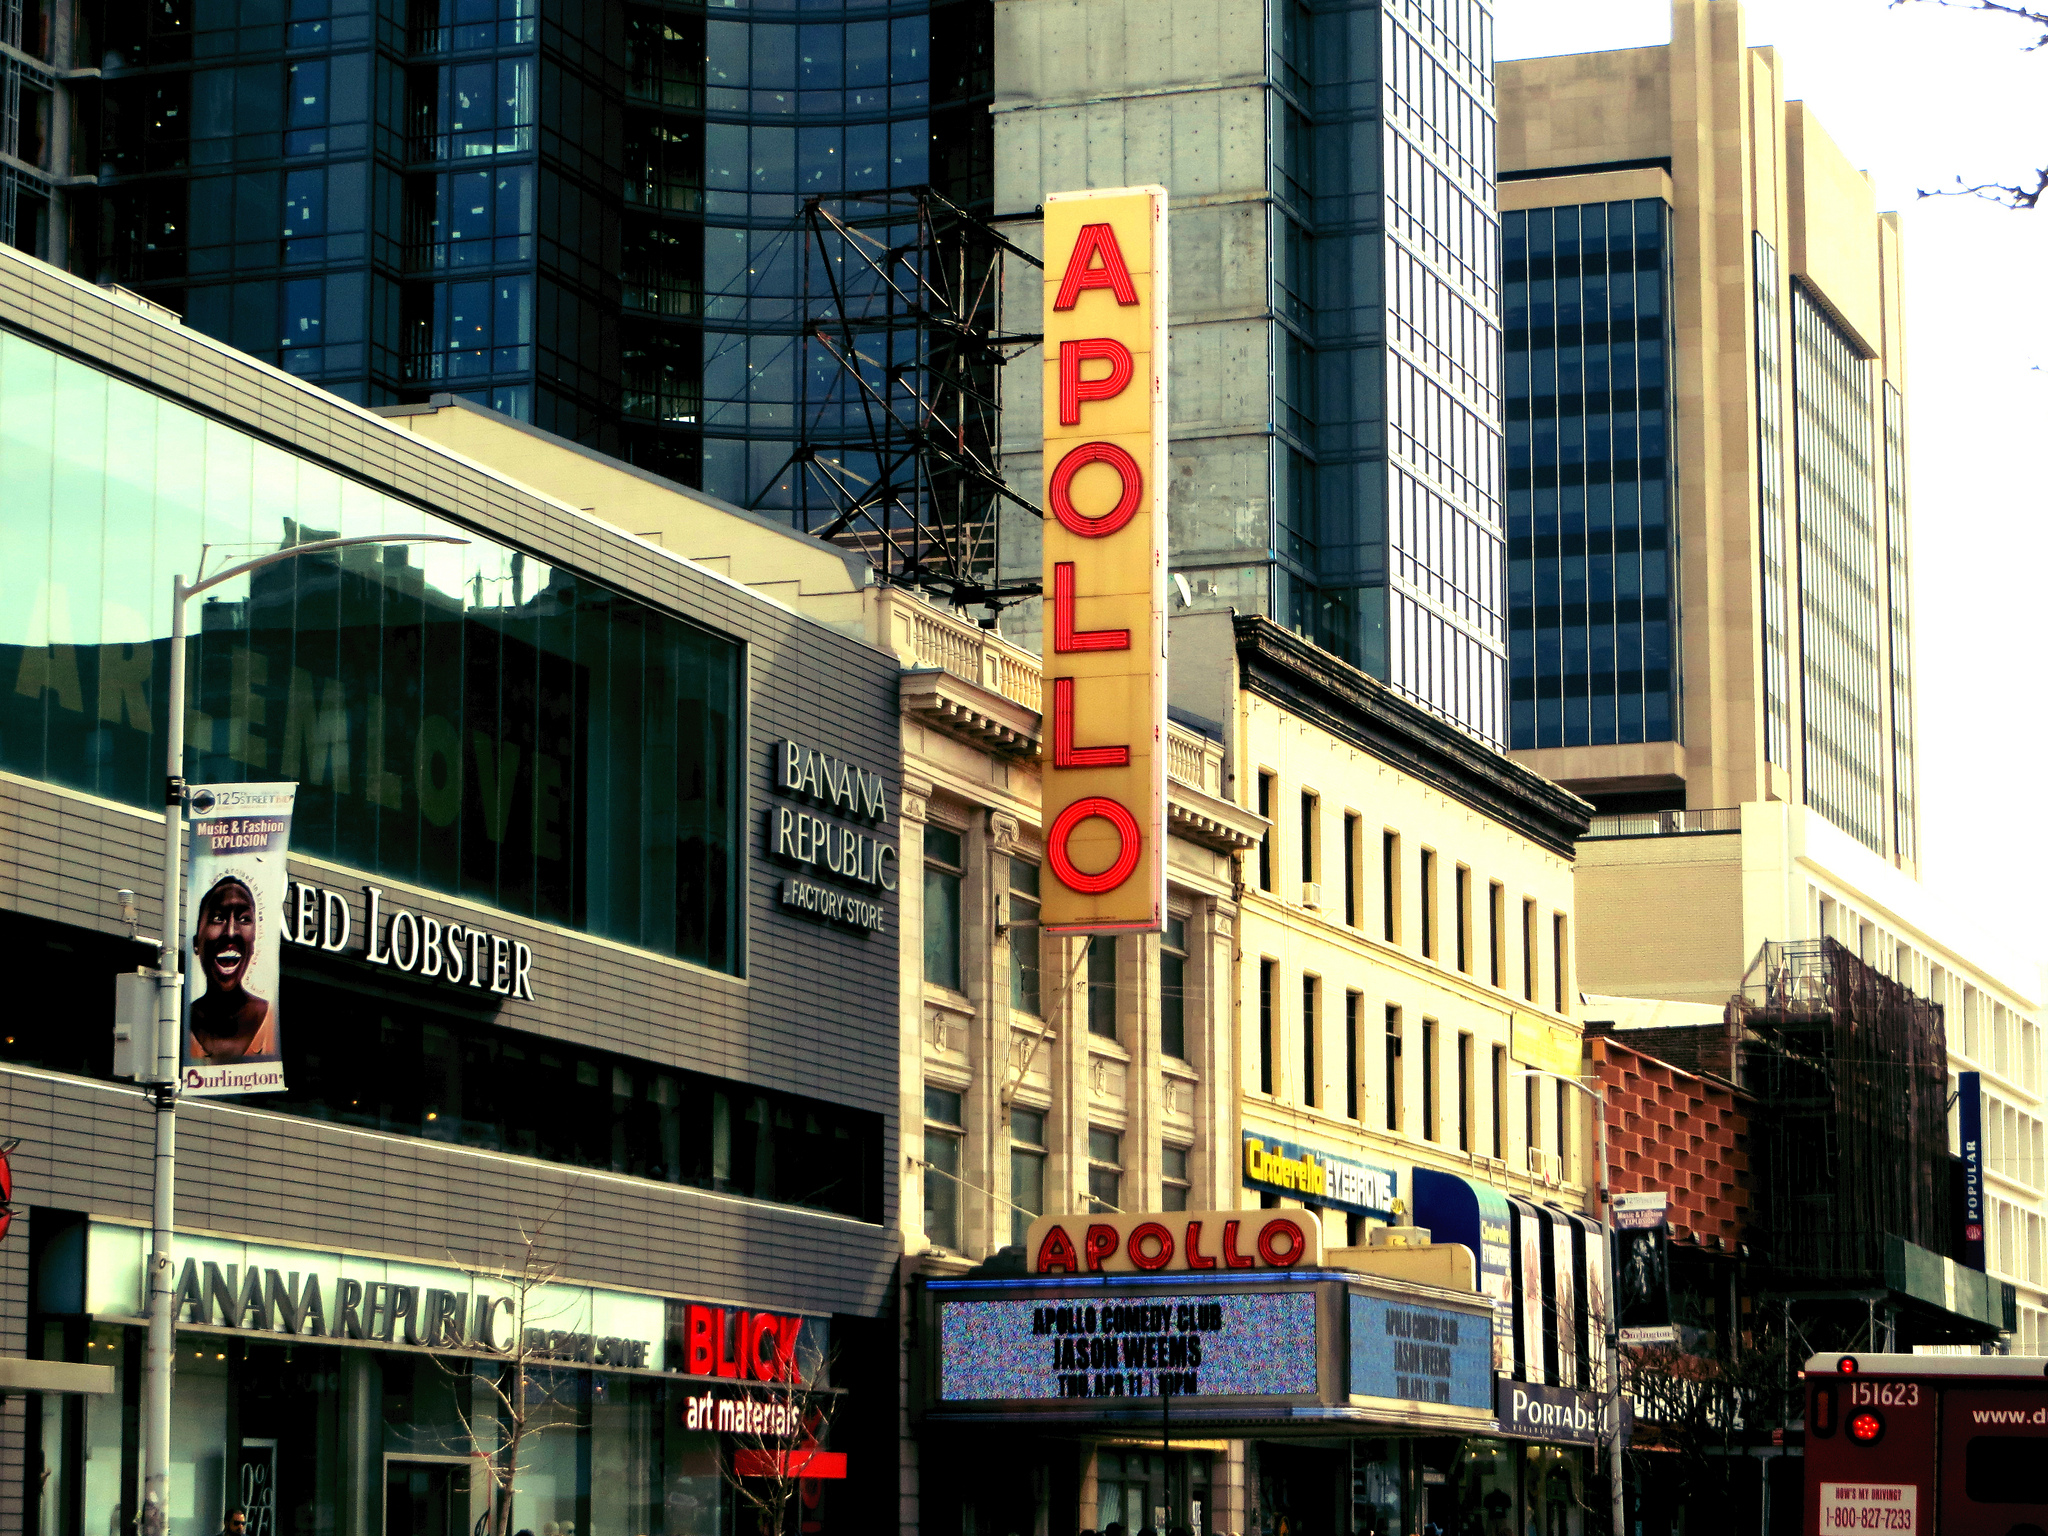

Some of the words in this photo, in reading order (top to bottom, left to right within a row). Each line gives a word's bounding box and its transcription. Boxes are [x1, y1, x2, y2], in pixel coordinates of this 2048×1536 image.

[1046, 222, 1143, 893] APOLLO
[240, 795, 275, 804] STREET
[785, 739, 888, 823] BANANA
[197, 821, 229, 836] Music
[231, 820, 240, 834] &
[242, 819, 285, 833] Fashion
[211, 833, 268, 850] EXPLOSION
[778, 806, 896, 891] REPUBLIC
[791, 879, 845, 921] FACTORY
[846, 897, 885, 932] STORE
[365, 886, 536, 1002] LOBSTER
[187, 1069, 279, 1091] Burlington
[1245, 1137, 1323, 1194] Cinderella
[1321, 1157, 1393, 1213] EYEBROWS
[1965, 1140, 1978, 1220] POPULAR
[1037, 1218, 1306, 1275] APOLLO
[144, 1253, 328, 1336] ANANA
[331, 1276, 516, 1355] REPUBLIC
[1033, 1307, 1097, 1335] APOLLO
[1101, 1305, 1173, 1334] COMEDY
[1177, 1302, 1223, 1332] CLUB
[684, 1304, 804, 1384] BLICK
[1053, 1337, 1119, 1370] JASON
[1122, 1335, 1202, 1369] WEEMS
[682, 1391, 714, 1431] art
[717, 1391, 800, 1436] materials
[1850, 1382, 1919, 1406] 151623
[1826, 1506, 1911, 1530] 1-800-827-7233
[1836, 1487, 1856, 1499] HOW'S
[1859, 1488, 1869, 1500] MY
[1872, 1489, 1902, 1501] DRIVING?
